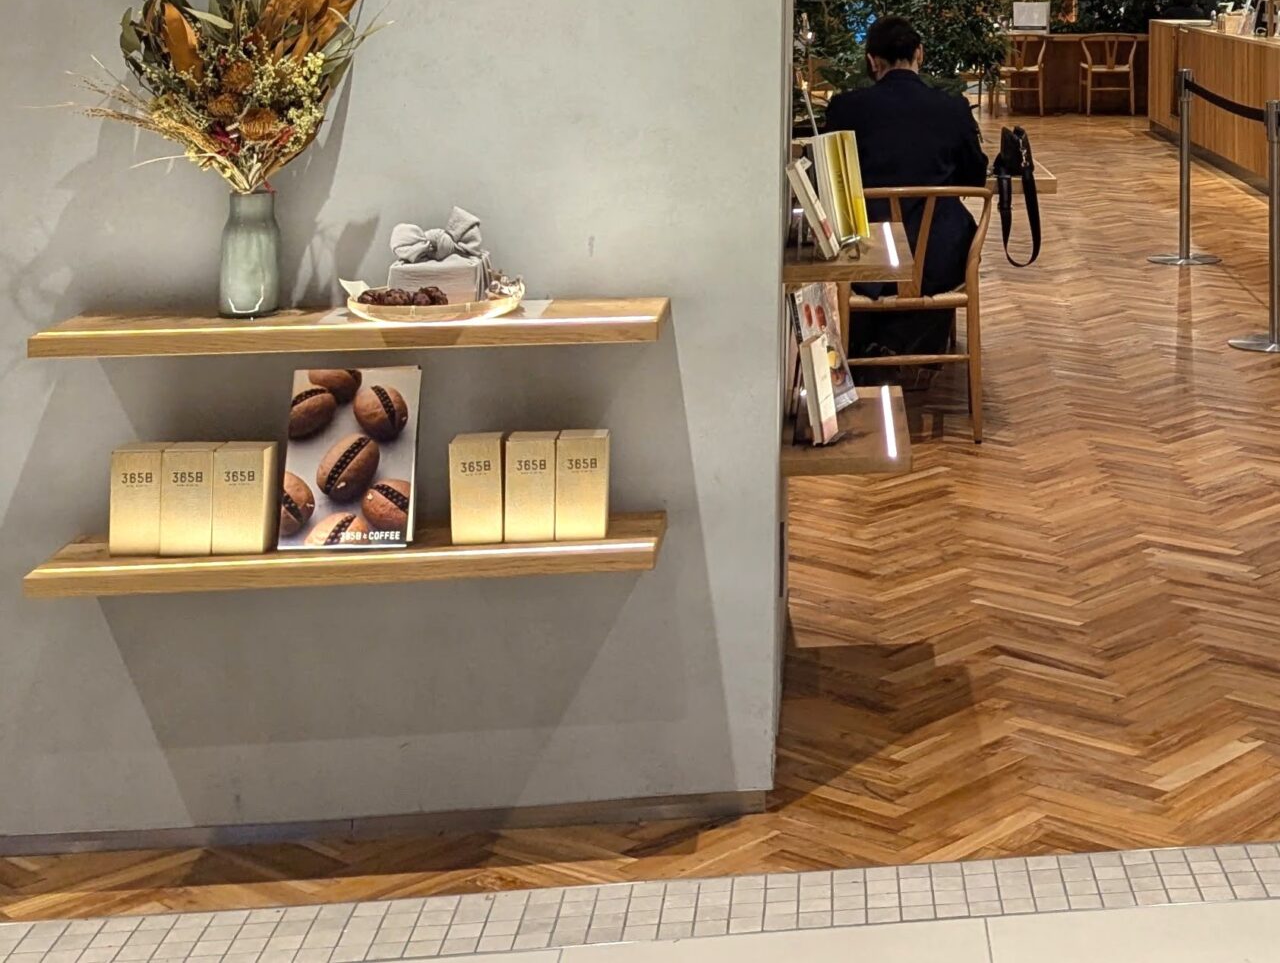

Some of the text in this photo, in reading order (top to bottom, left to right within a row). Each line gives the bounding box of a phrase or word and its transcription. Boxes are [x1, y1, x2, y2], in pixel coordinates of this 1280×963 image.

[460, 460, 491, 474] 365日
[516, 459, 547, 472] 365日
[567, 458, 598, 470] 365日
[121, 472, 153, 485] 365日
[172, 471, 204, 483] 365日
[224, 470, 255, 482] 365日
[368, 530, 401, 541] COFFEE
